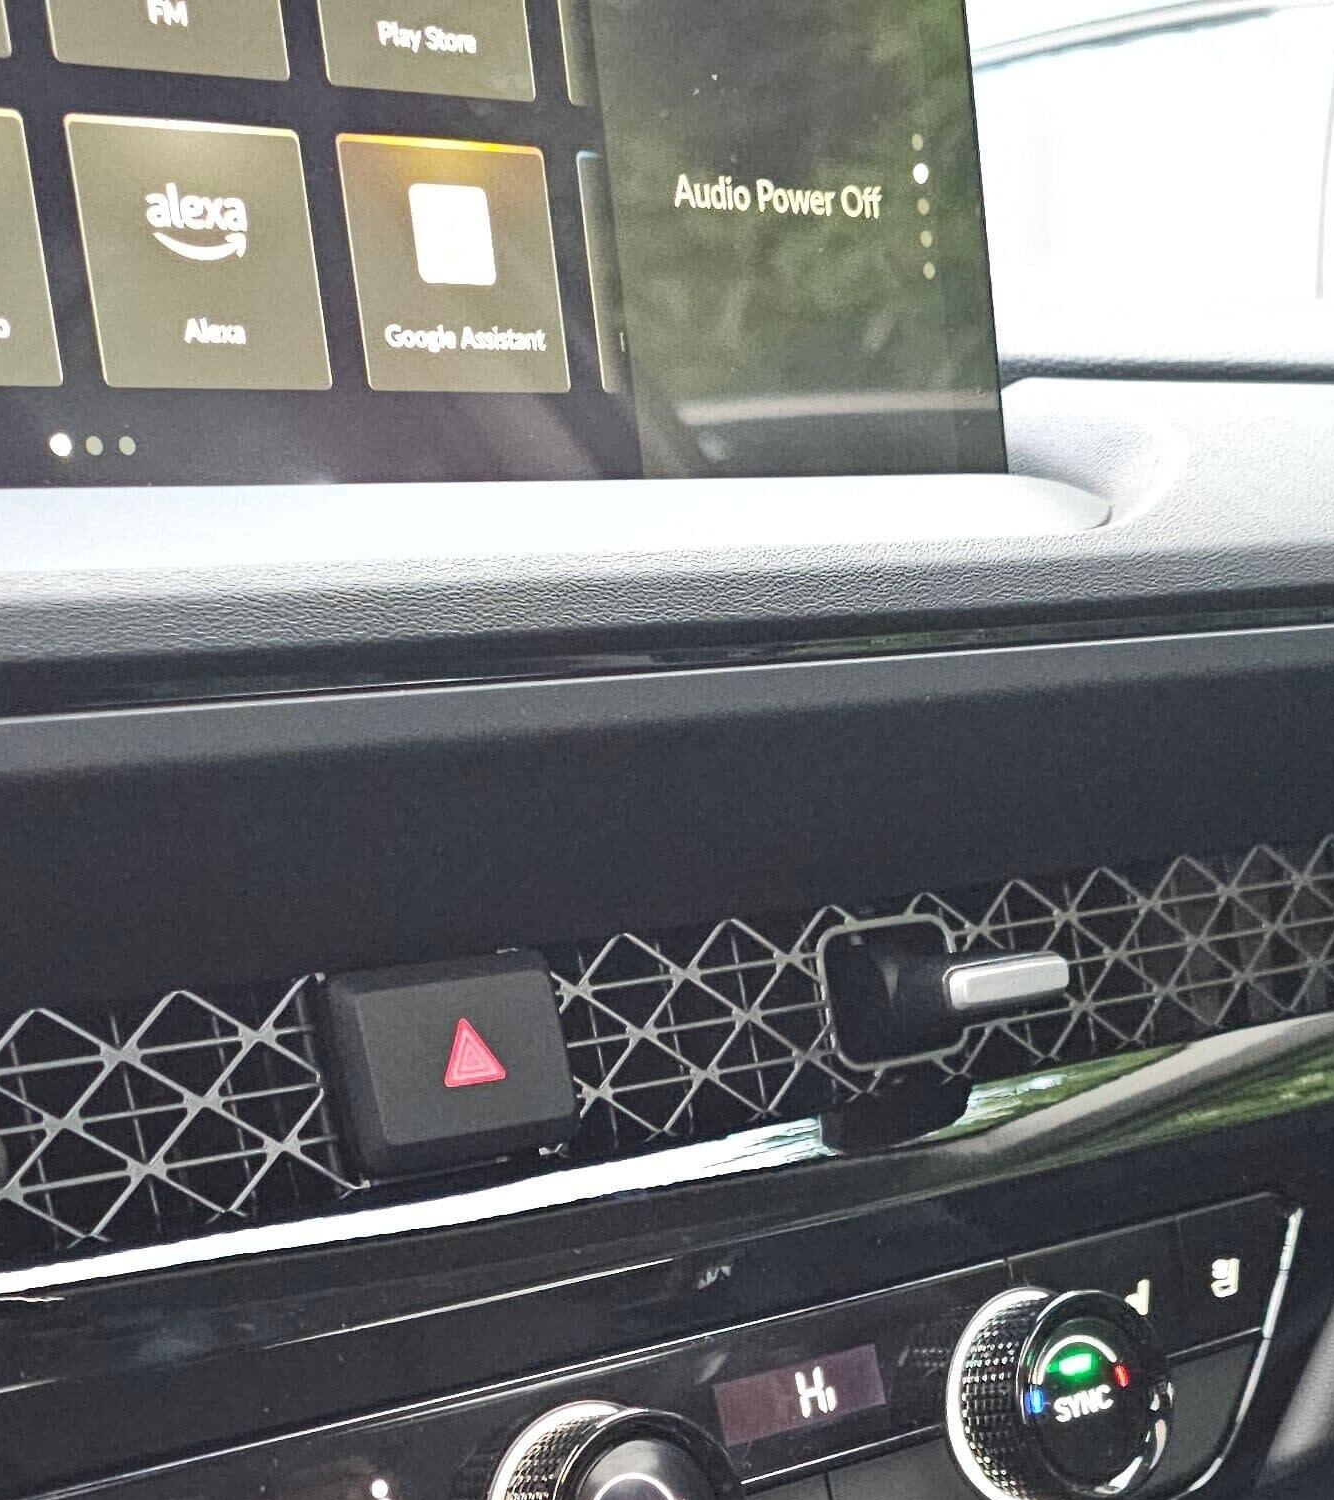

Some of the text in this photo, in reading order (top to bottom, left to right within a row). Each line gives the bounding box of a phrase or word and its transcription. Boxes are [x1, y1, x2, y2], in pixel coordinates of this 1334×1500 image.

[148, 0, 189, 27] FM
[378, 20, 478, 54] Play Store
[145, 182, 248, 232] alexa
[674, 173, 882, 219] Audio Power Off
[183, 317, 247, 346] Alexa
[384, 323, 548, 354] Google Assistant
[1054, 1384, 1114, 1423] SYNC
